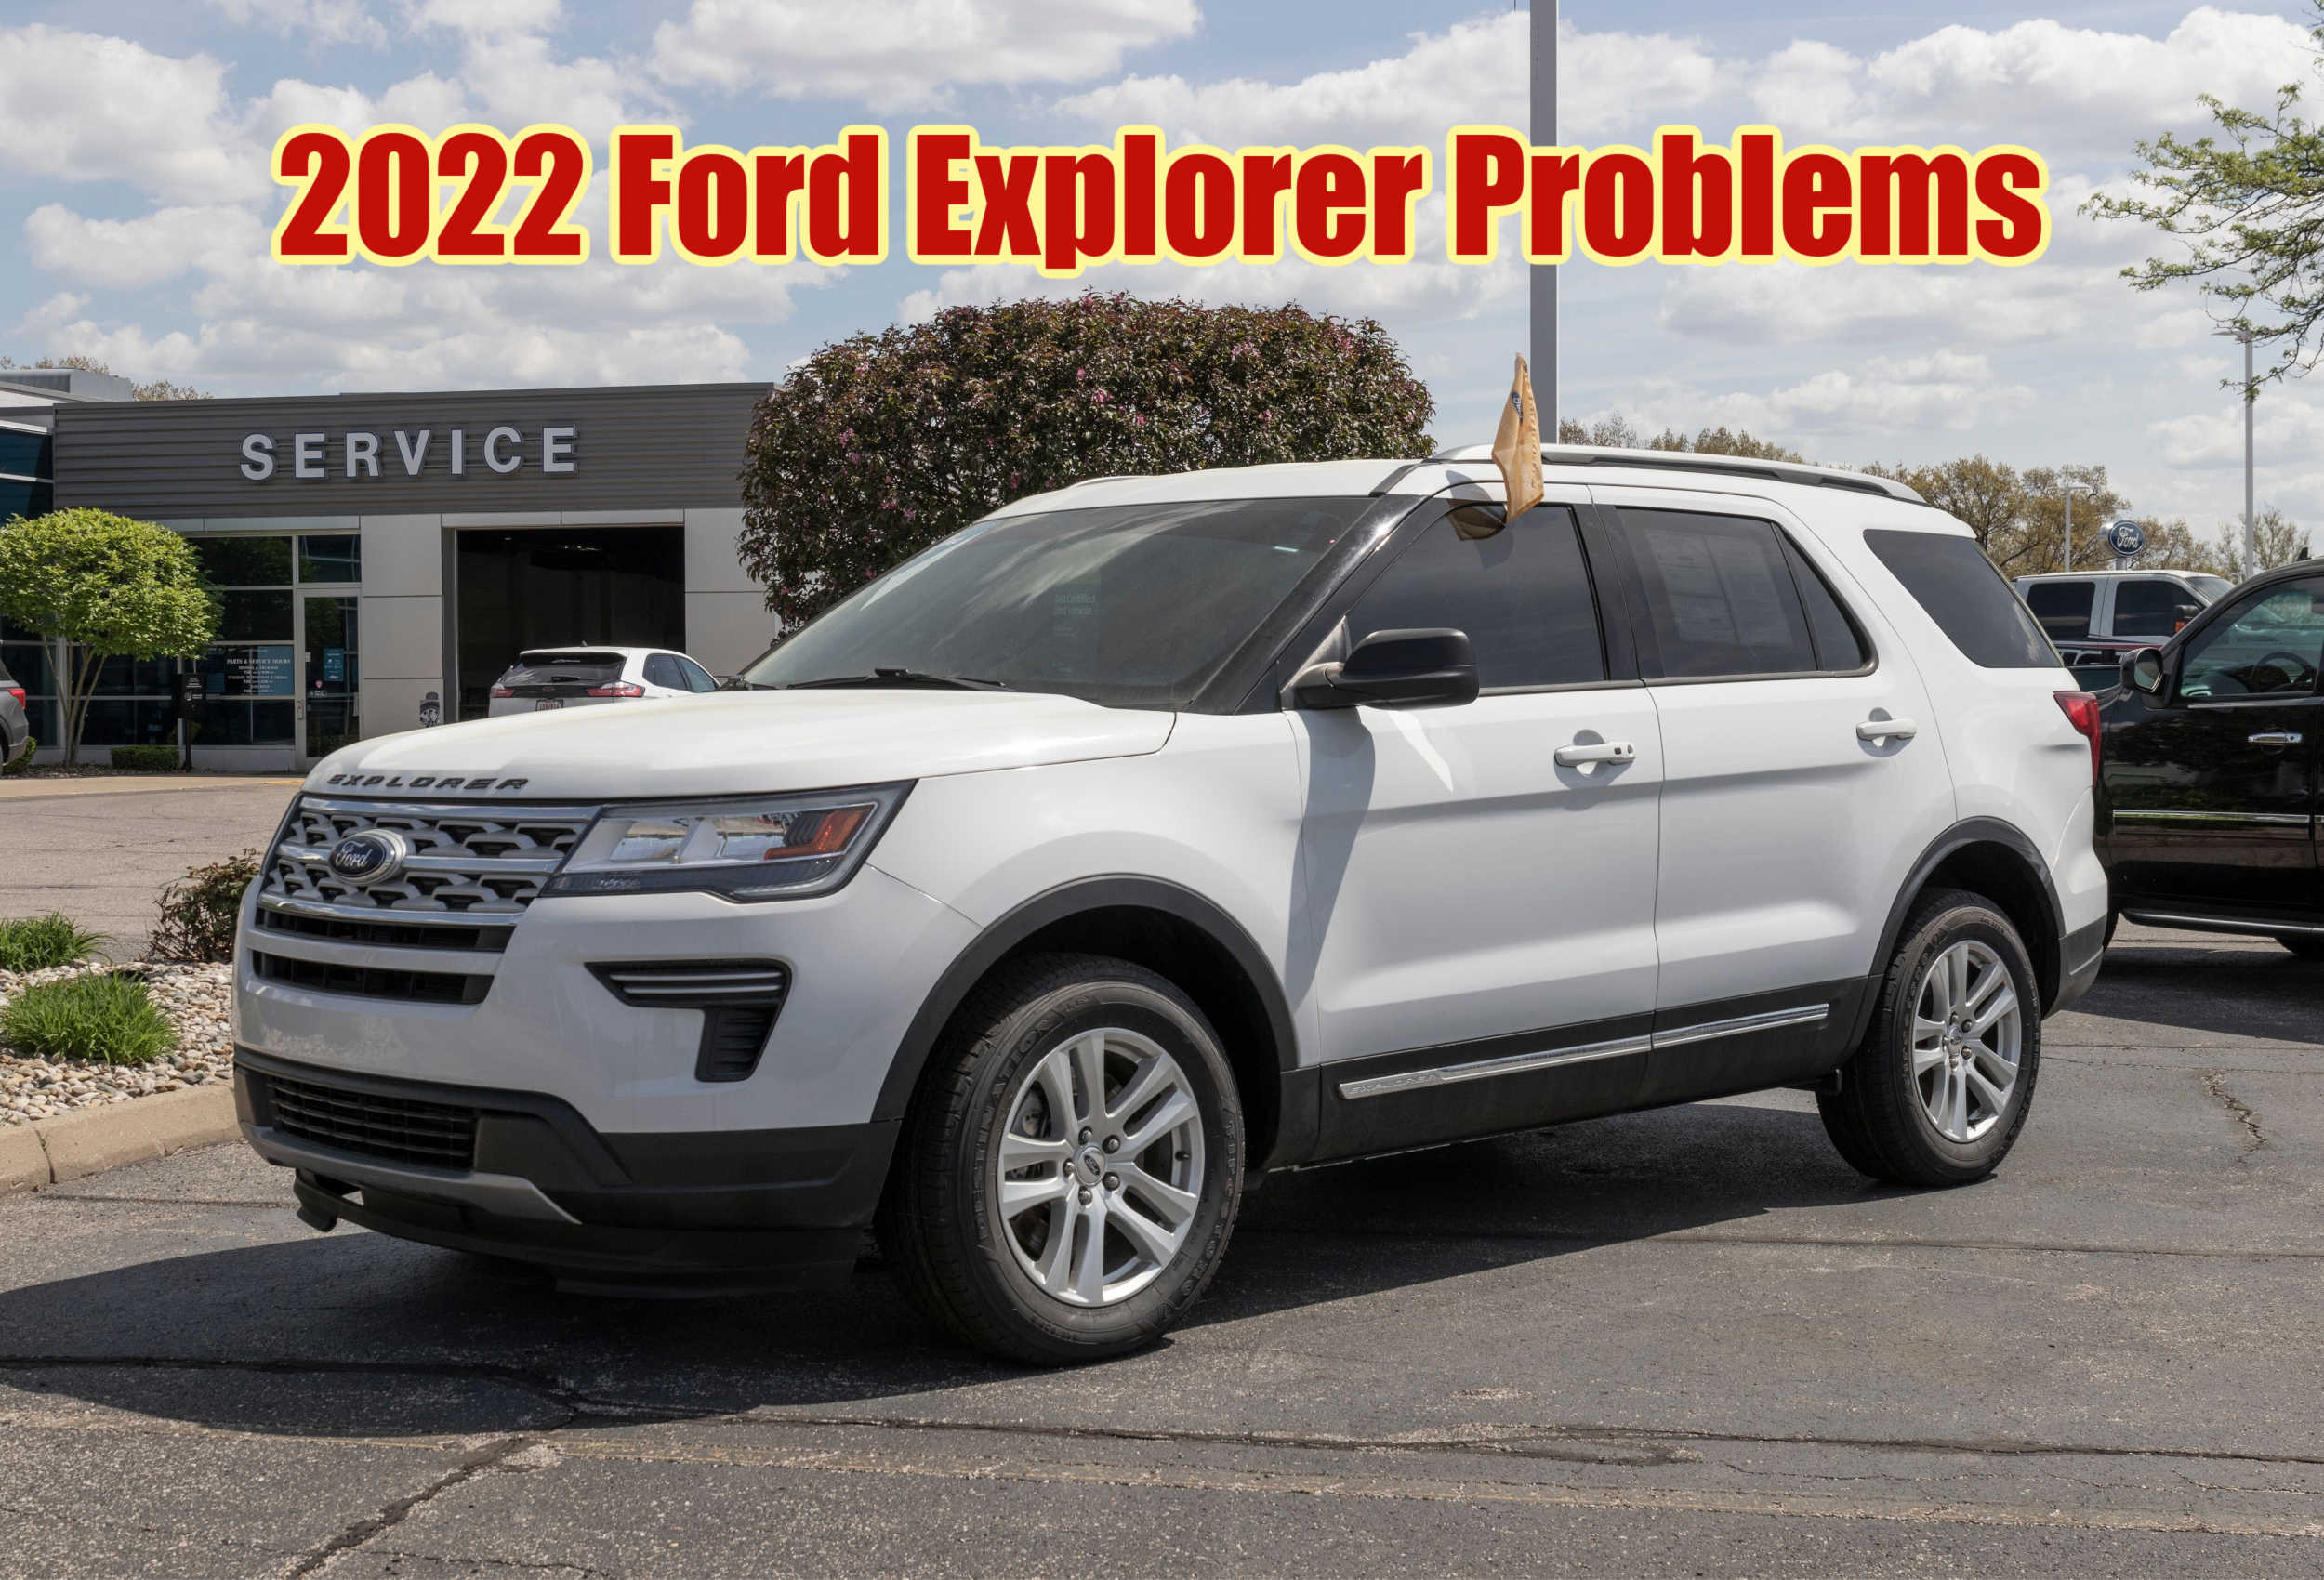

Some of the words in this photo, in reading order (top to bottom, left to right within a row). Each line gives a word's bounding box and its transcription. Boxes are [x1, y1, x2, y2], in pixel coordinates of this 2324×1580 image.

[240, 424, 576, 481] SERVICE
[2117, 526, 2140, 548] Ford
[327, 773, 529, 790] EXPLORER
[335, 839, 374, 869] Ford
